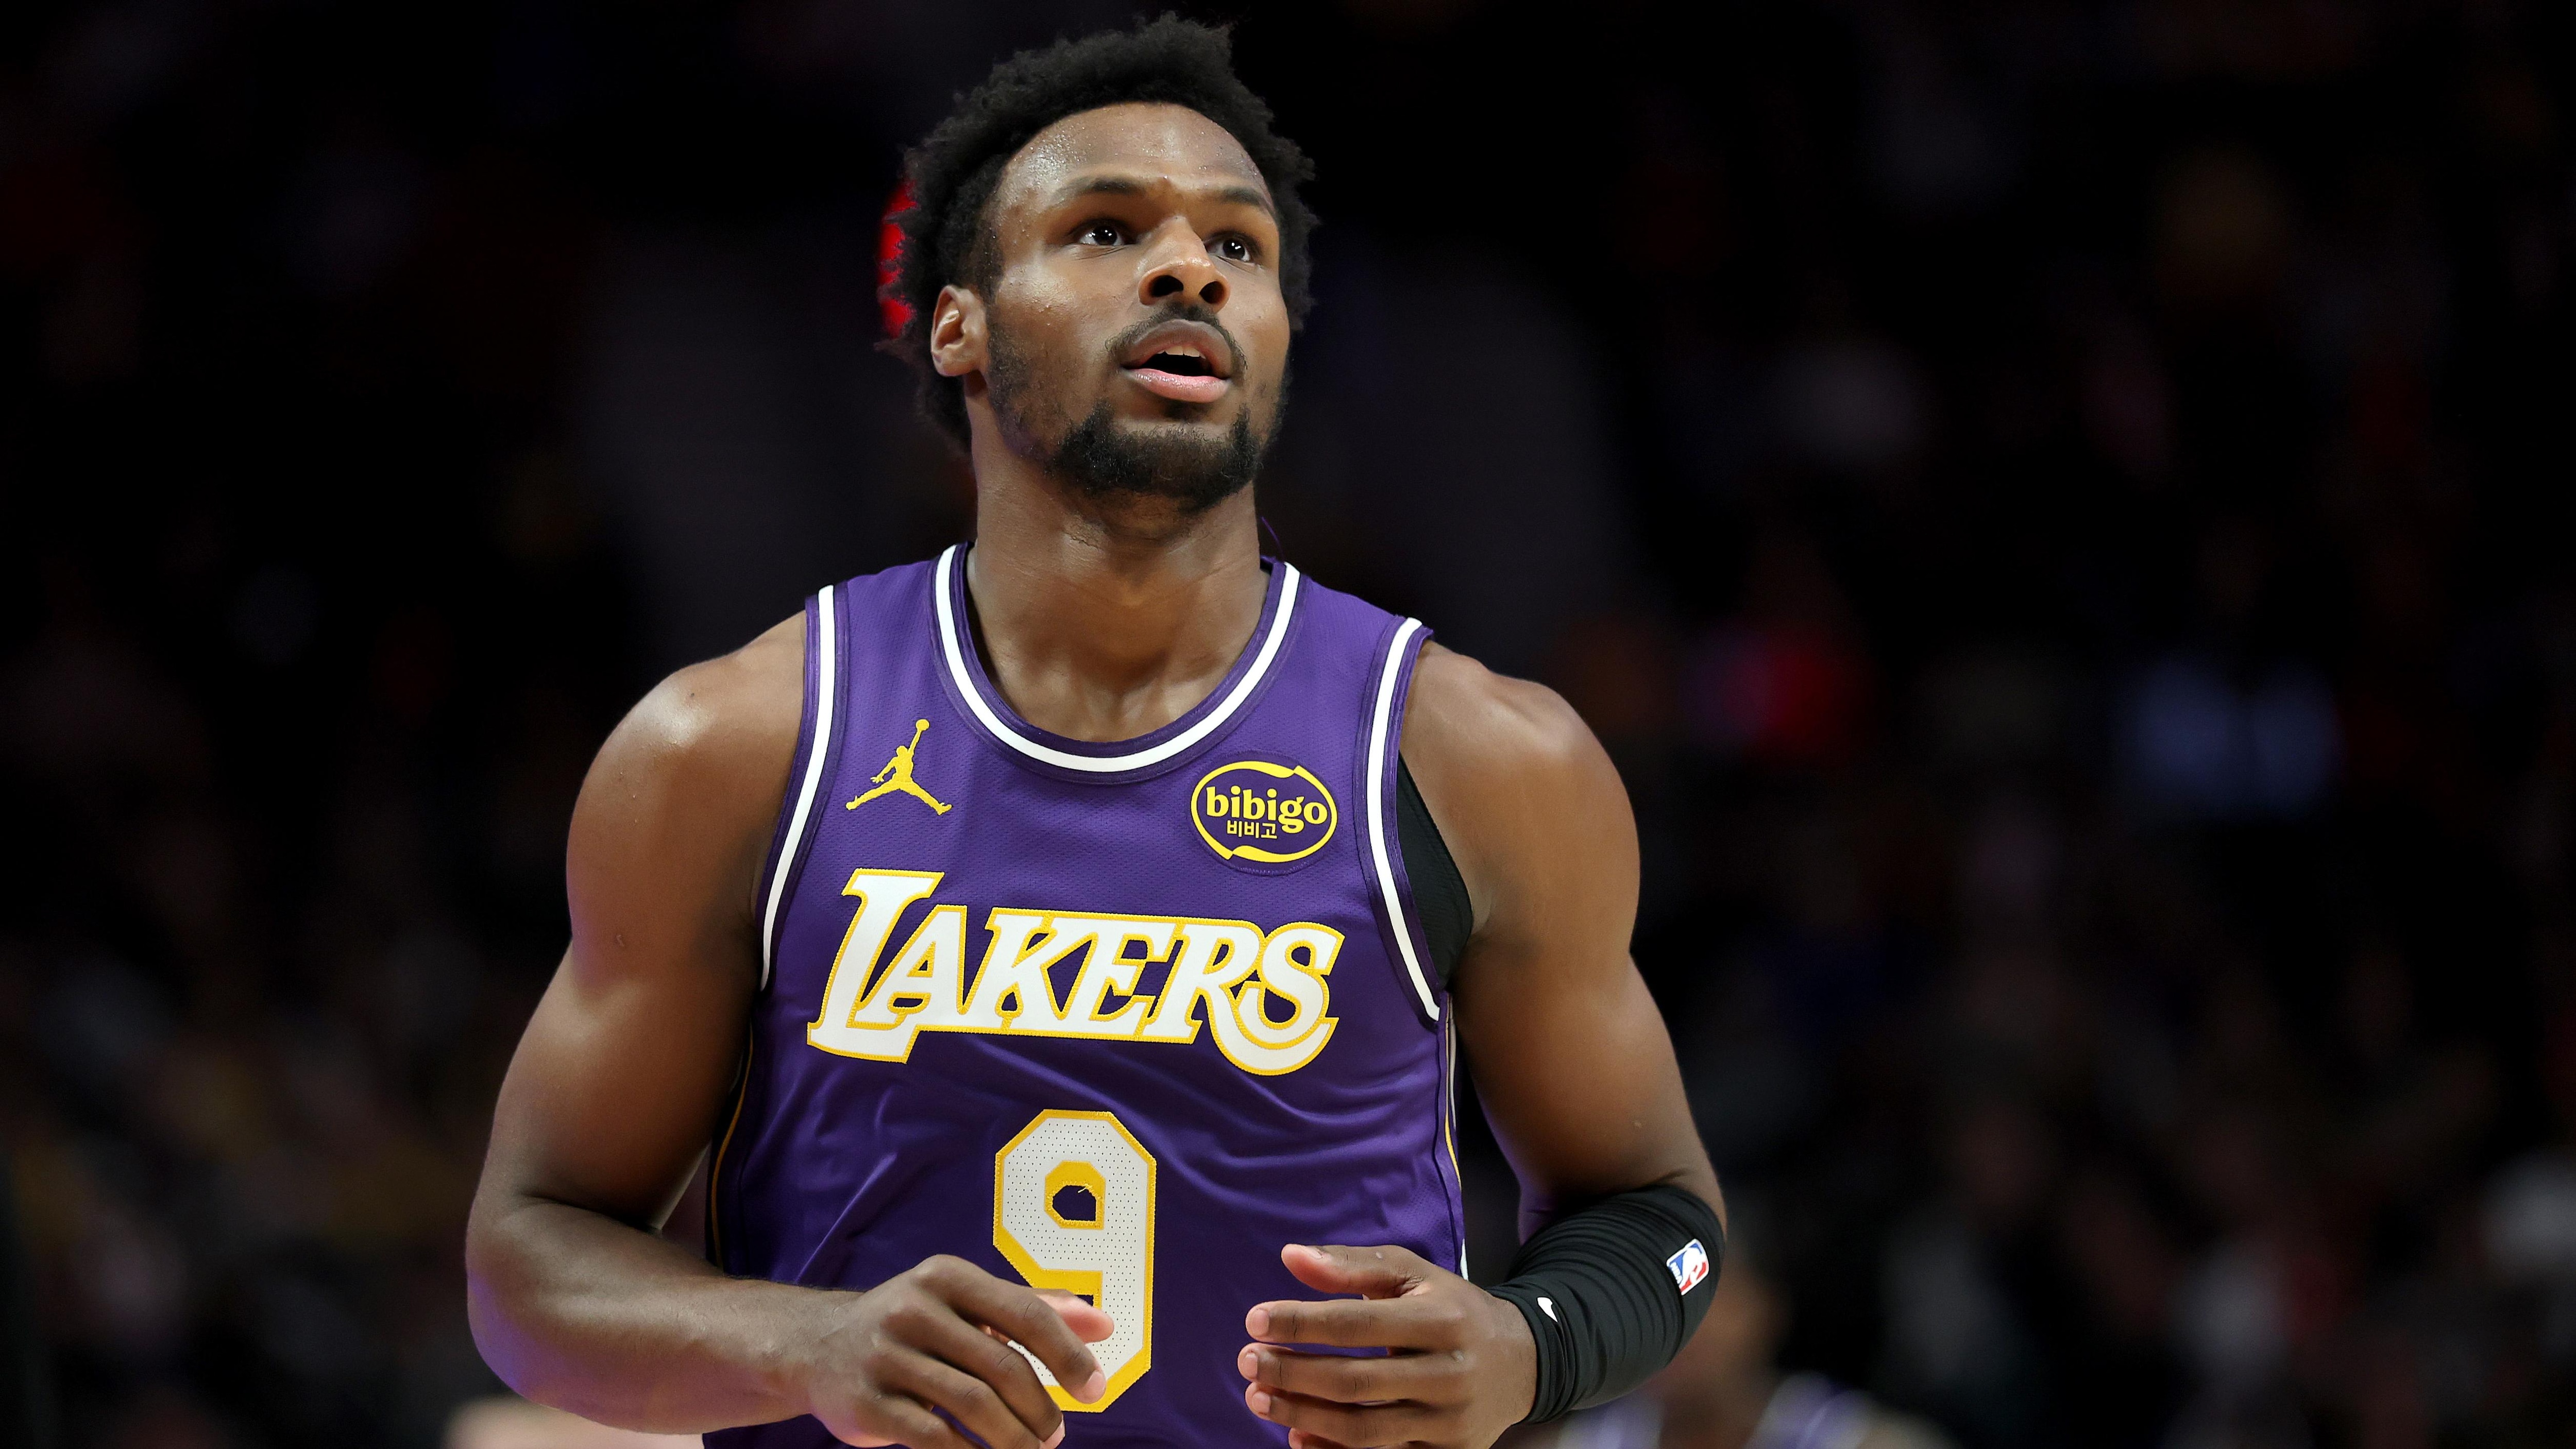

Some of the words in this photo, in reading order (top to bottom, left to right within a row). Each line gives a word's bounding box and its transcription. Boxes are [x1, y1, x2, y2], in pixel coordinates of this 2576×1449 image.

[1206, 785, 1328, 833] bibigo
[1227, 820, 1277, 839] 비비고
[807, 868, 1345, 1076] LAKERS
[993, 1109, 1157, 1413] 9
